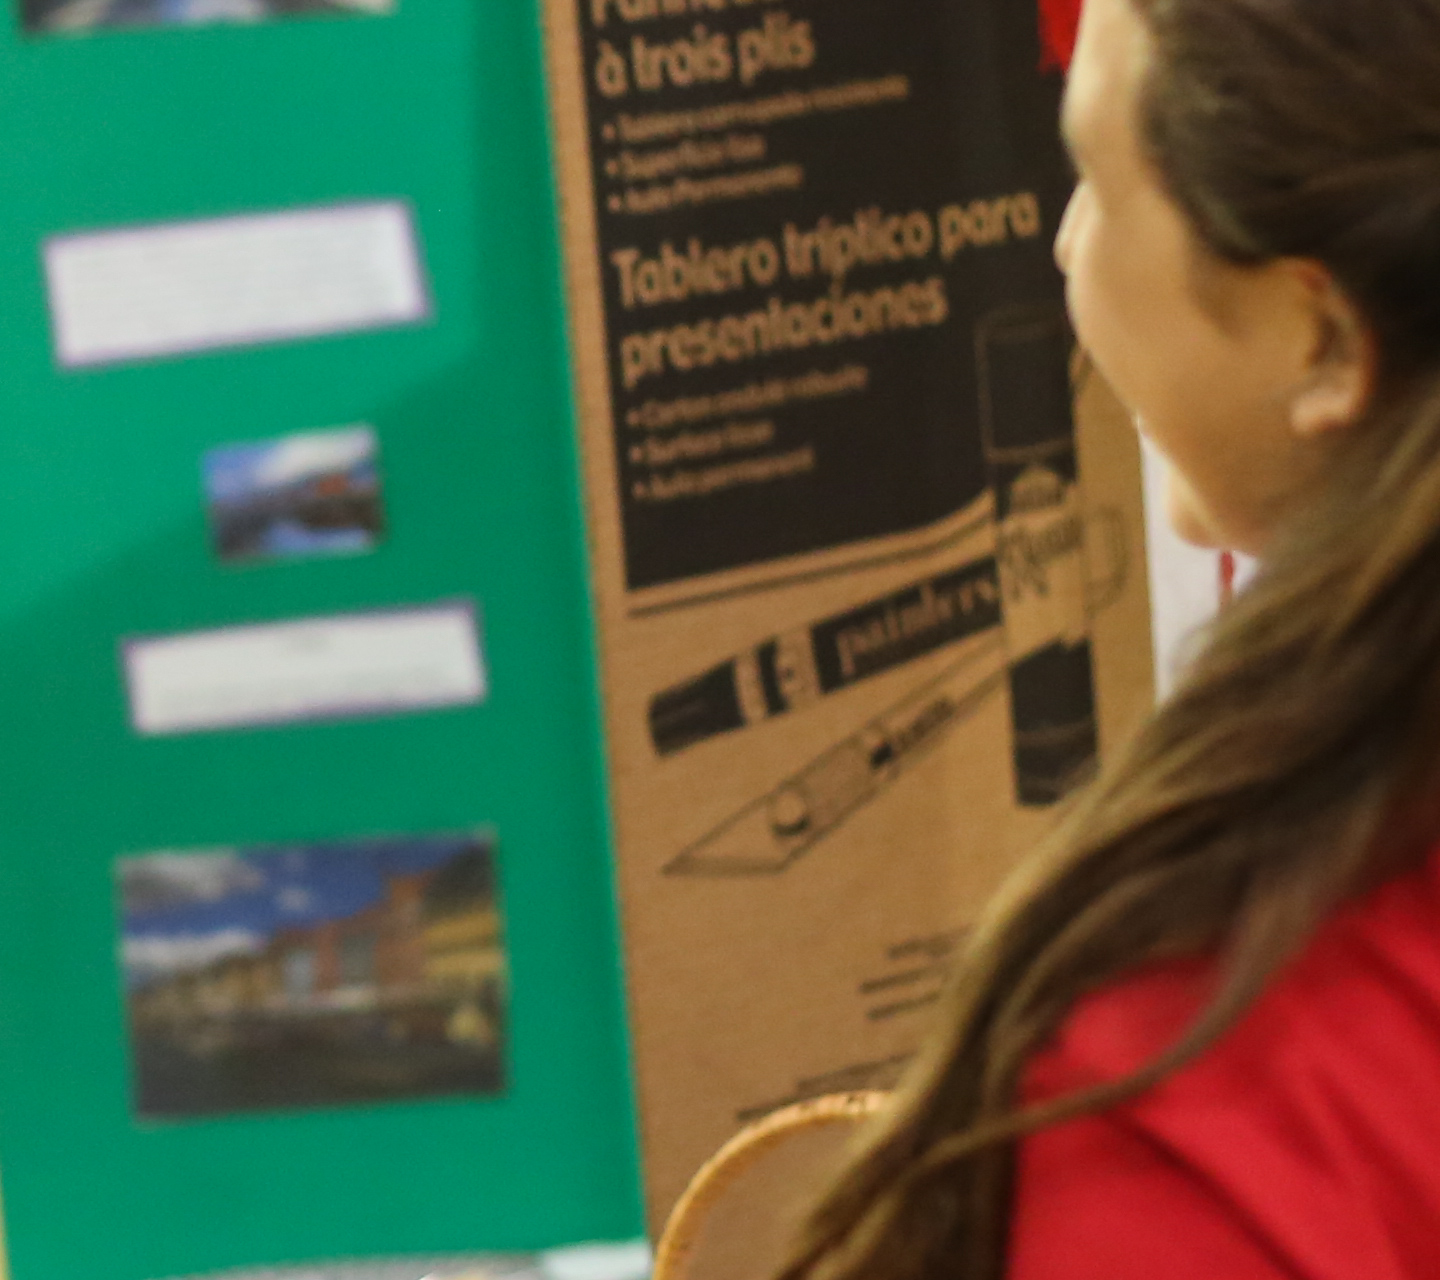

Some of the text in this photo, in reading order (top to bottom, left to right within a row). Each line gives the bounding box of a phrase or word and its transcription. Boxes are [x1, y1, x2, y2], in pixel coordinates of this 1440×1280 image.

[631, 24, 729, 88] trois
[737, 12, 815, 85] plis
[611, 239, 779, 310] Tablero
[939, 191, 1040, 262] para
[620, 276, 948, 388] presentaciones
